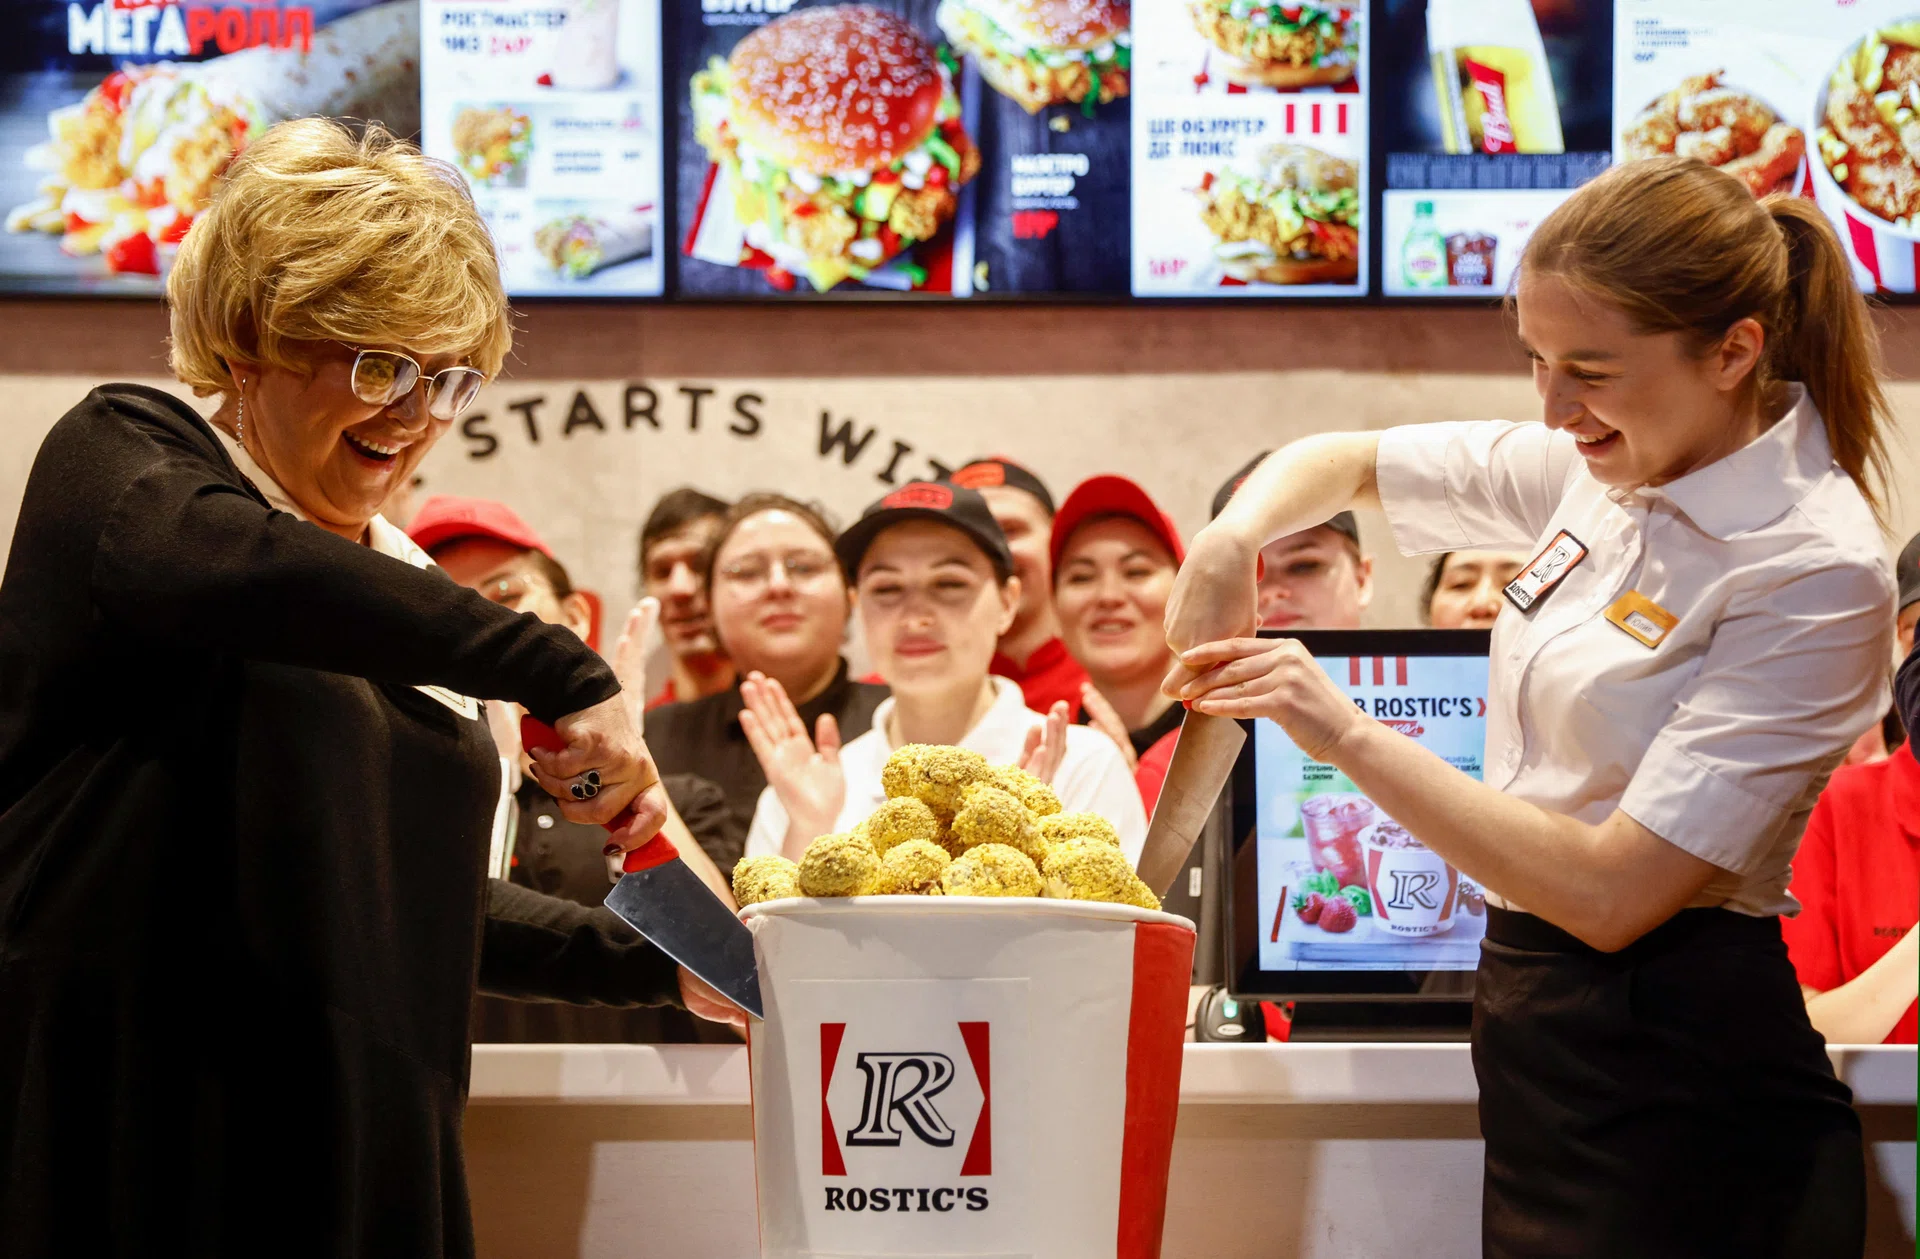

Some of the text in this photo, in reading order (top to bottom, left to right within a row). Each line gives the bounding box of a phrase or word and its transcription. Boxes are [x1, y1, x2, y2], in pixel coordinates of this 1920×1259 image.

[461, 384, 764, 458] STARTS
[1508, 582, 1534, 606] ROSTIC'S
[1374, 697, 1472, 717] ROSTIC'S
[1391, 924, 1438, 933] ROSTIC'S
[845, 1052, 956, 1148] R
[824, 1186, 989, 1212] ROSTIC'S
